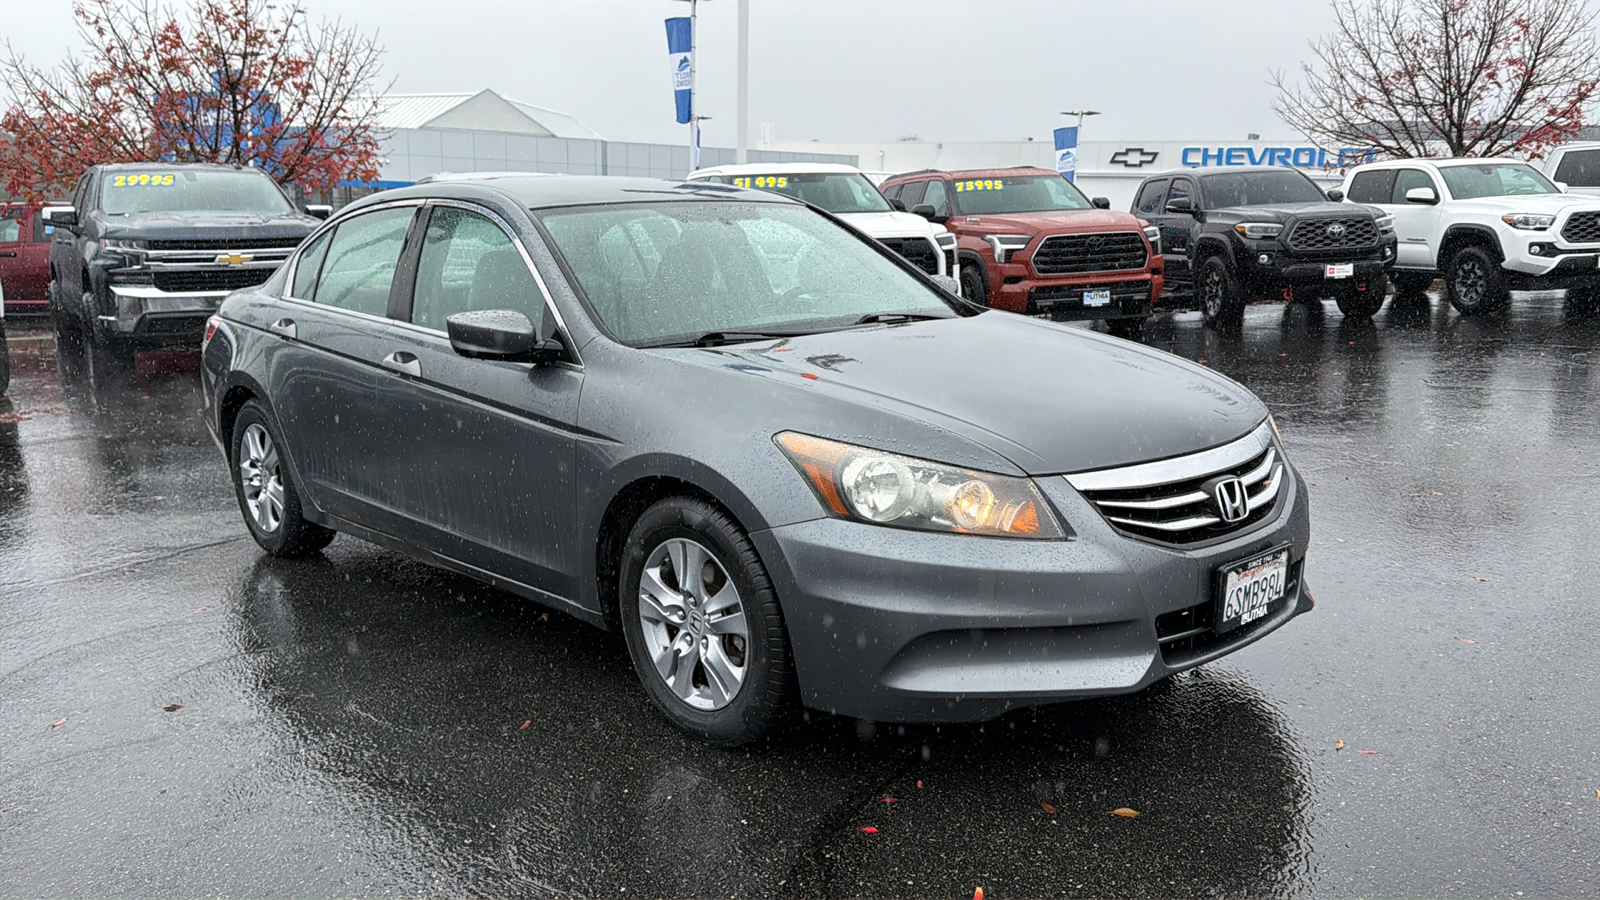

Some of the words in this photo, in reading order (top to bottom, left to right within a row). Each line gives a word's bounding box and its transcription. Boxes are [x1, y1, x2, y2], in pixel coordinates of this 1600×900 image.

[113, 174, 174, 187] 29995
[755, 176, 787, 188] 495
[955, 180, 1003, 192] 73995
[1226, 570, 1282, 619] 6SMB984
